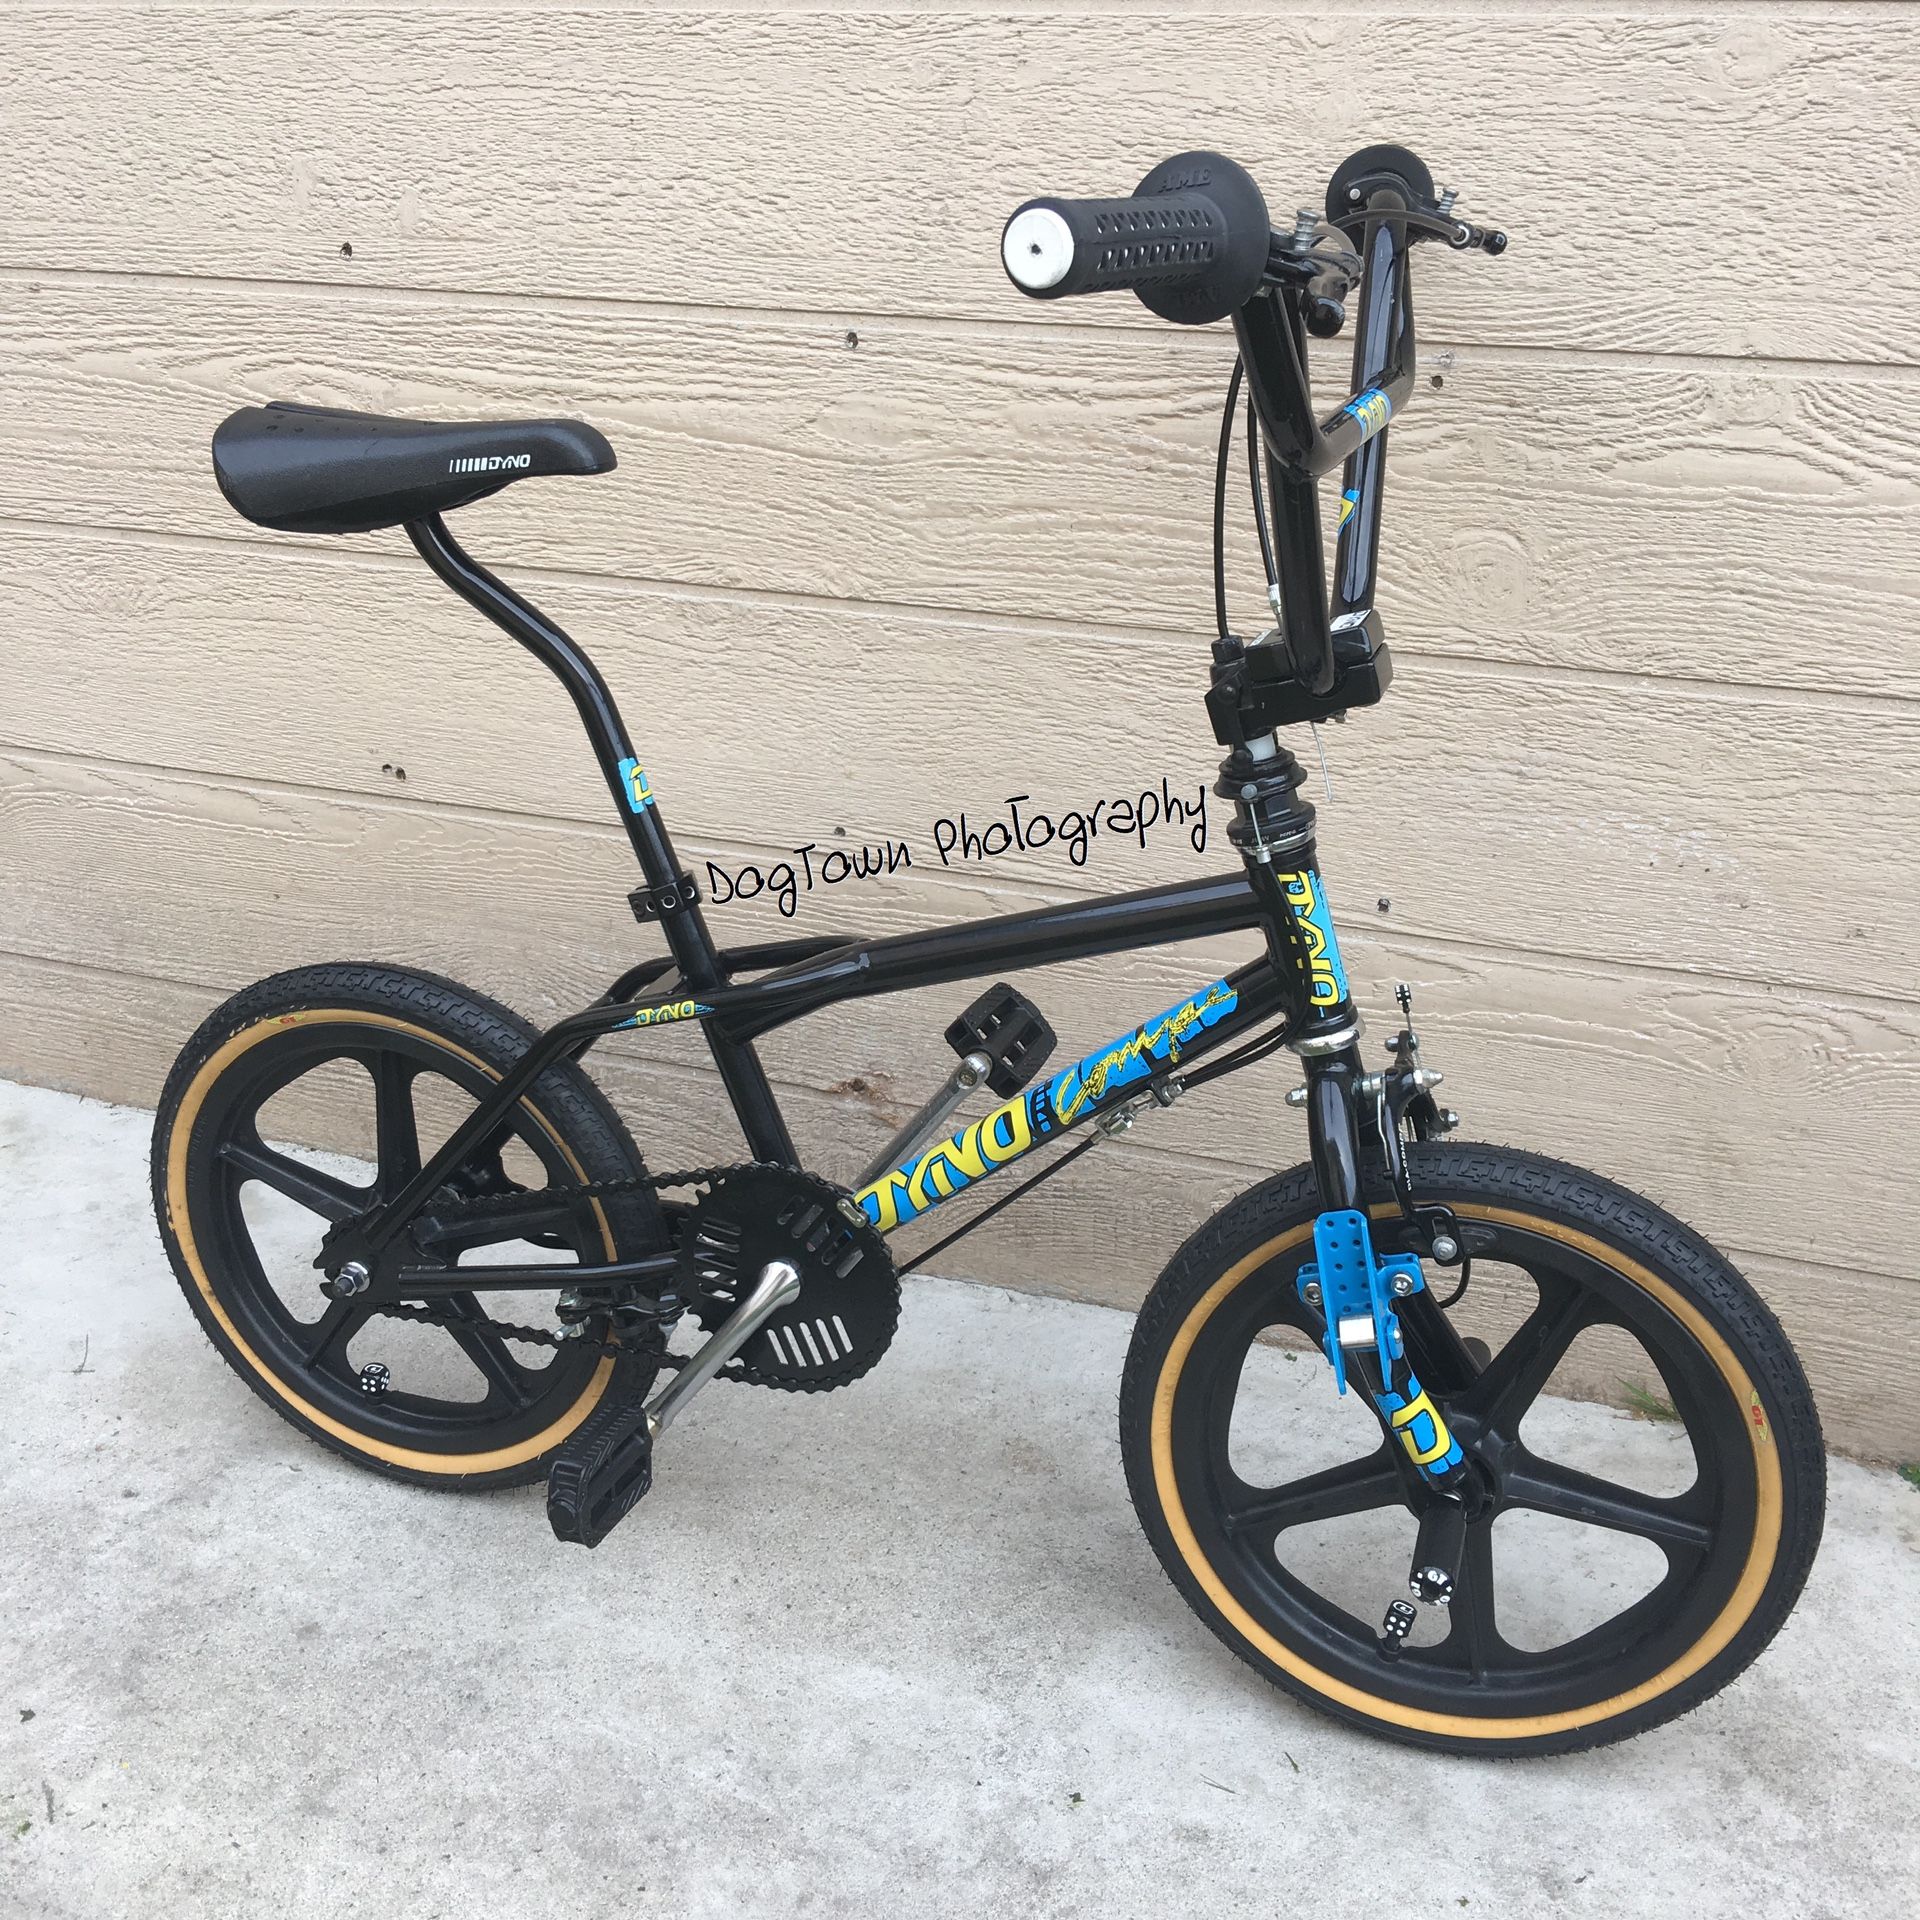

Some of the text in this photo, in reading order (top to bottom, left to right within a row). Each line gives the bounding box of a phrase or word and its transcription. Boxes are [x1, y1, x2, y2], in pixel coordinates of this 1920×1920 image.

[488, 453, 531, 470] DYNO
[635, 1000, 695, 1026] DYNO
[852, 1095, 1033, 1233] DYNO
[1391, 1389, 1451, 1465] D
[1427, 1569, 1448, 1586] GT
